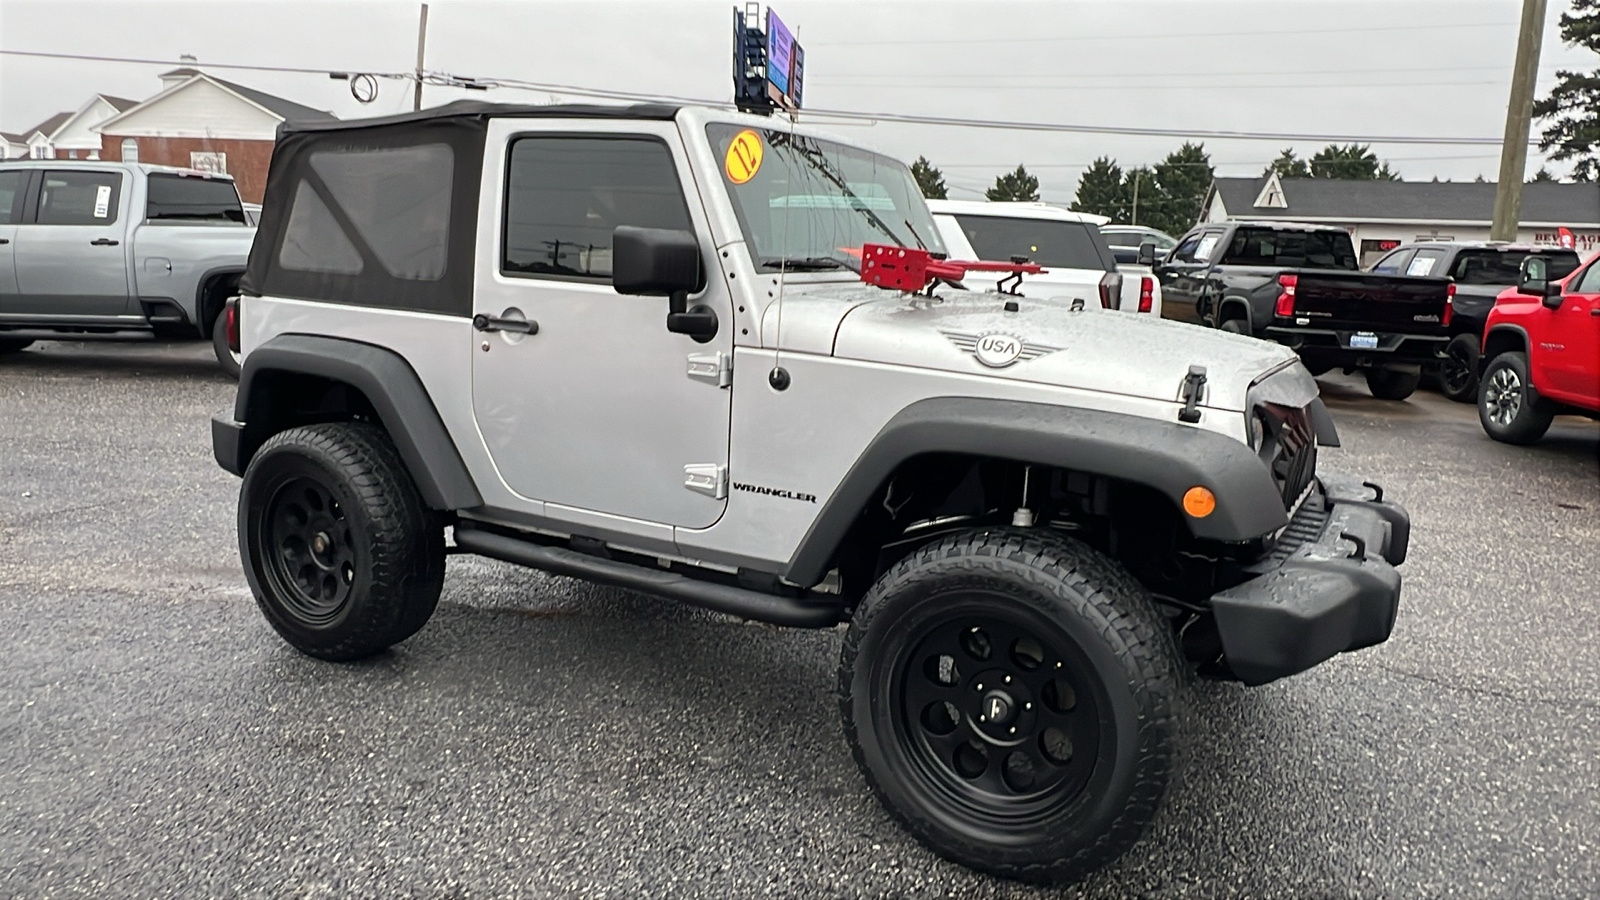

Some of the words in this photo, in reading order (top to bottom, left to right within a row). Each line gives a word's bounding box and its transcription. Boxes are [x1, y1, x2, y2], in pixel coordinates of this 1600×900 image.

[733, 137, 757, 177] 12
[981, 338, 1015, 355] USA
[732, 481, 817, 504] WRANGLER
